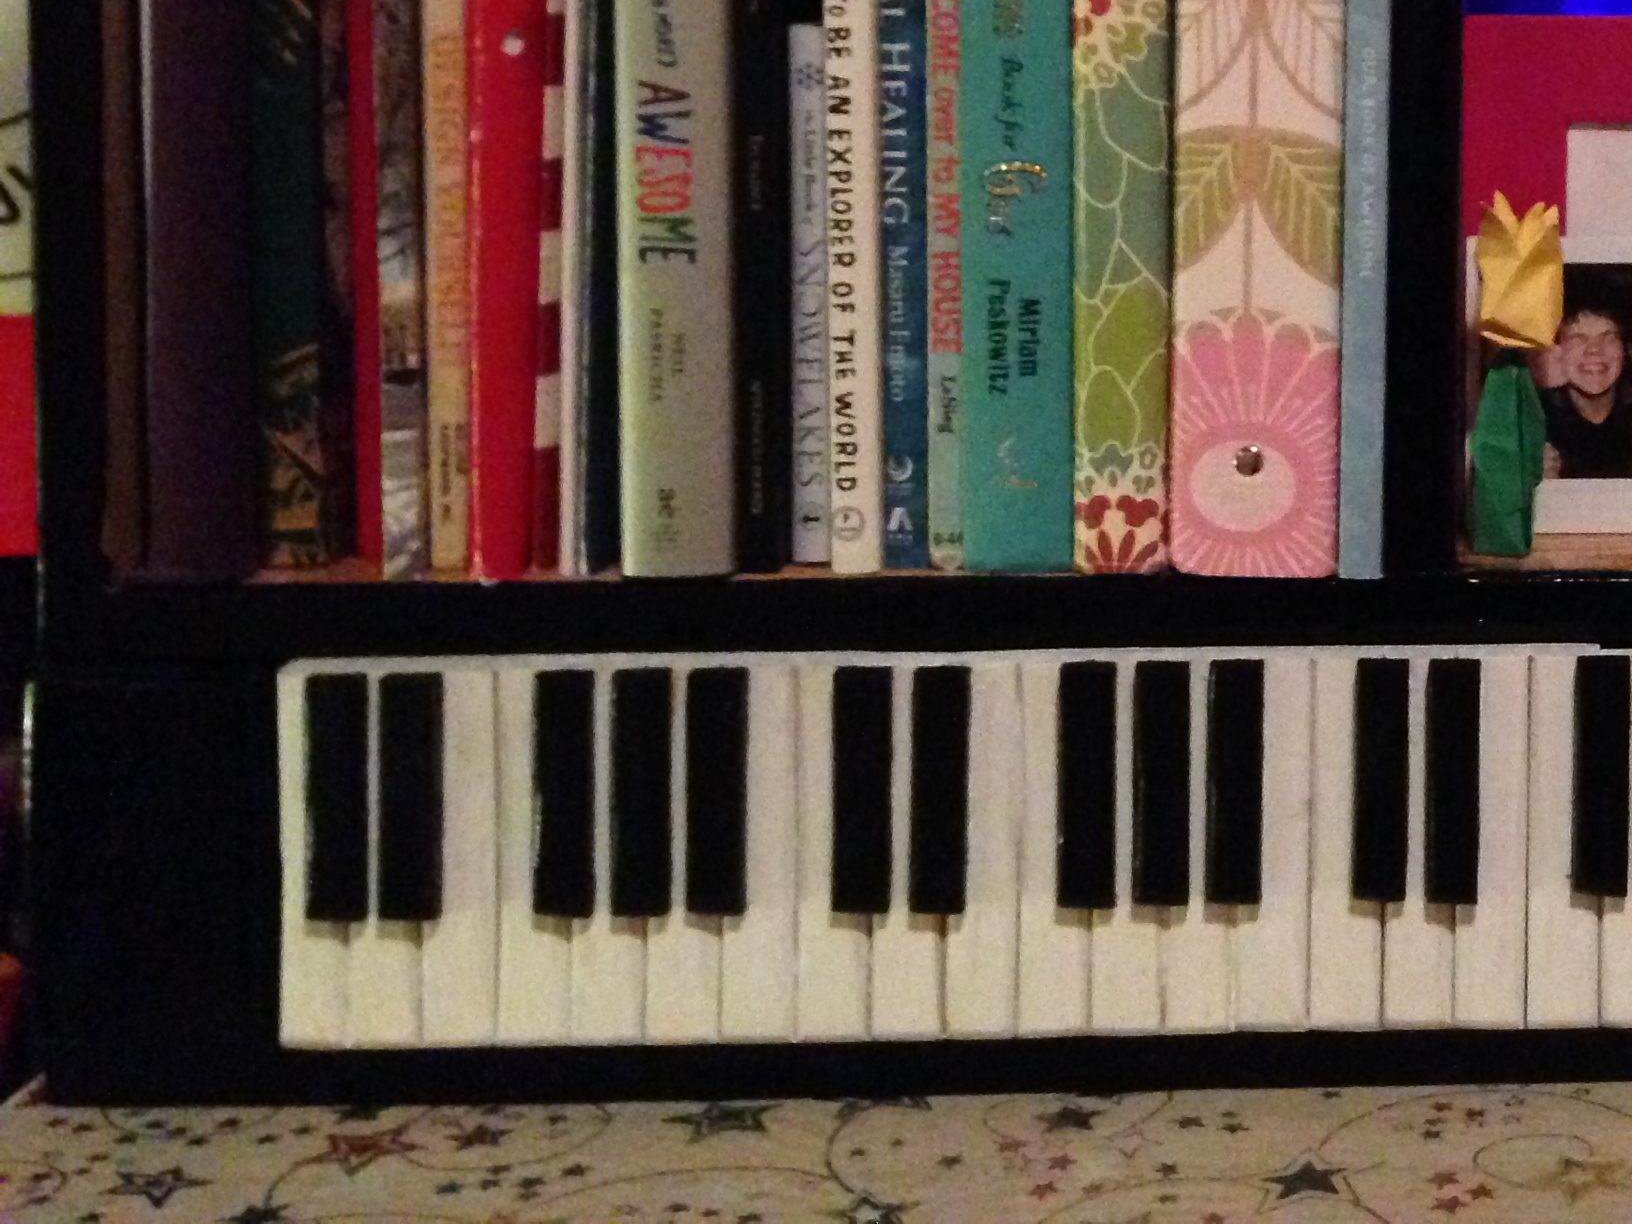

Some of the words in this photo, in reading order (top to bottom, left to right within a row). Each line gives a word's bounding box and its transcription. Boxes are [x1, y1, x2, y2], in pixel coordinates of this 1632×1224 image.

[827, 27, 851, 58] BE
[1360, 47, 1376, 91] OUR
[827, 76, 851, 115] AN
[1000, 56, 1025, 112] Book
[881, 42, 911, 225] HEALING
[994, 113, 1023, 152] for
[1360, 98, 1376, 145] BOOK
[635, 80, 697, 264] AWESOME
[827, 128, 857, 268] EXPLORER
[932, 193, 961, 239] MY
[1358, 181, 1376, 278] AWESOME
[831, 281, 855, 313] OF
[930, 249, 963, 353] HOUSE
[796, 240, 824, 489] SNOWFLAKES
[832, 329, 857, 381] THE
[987, 278, 1012, 395] Peskowitz
[1017, 296, 1043, 377] Miriam
[834, 391, 858, 492] WORLD
